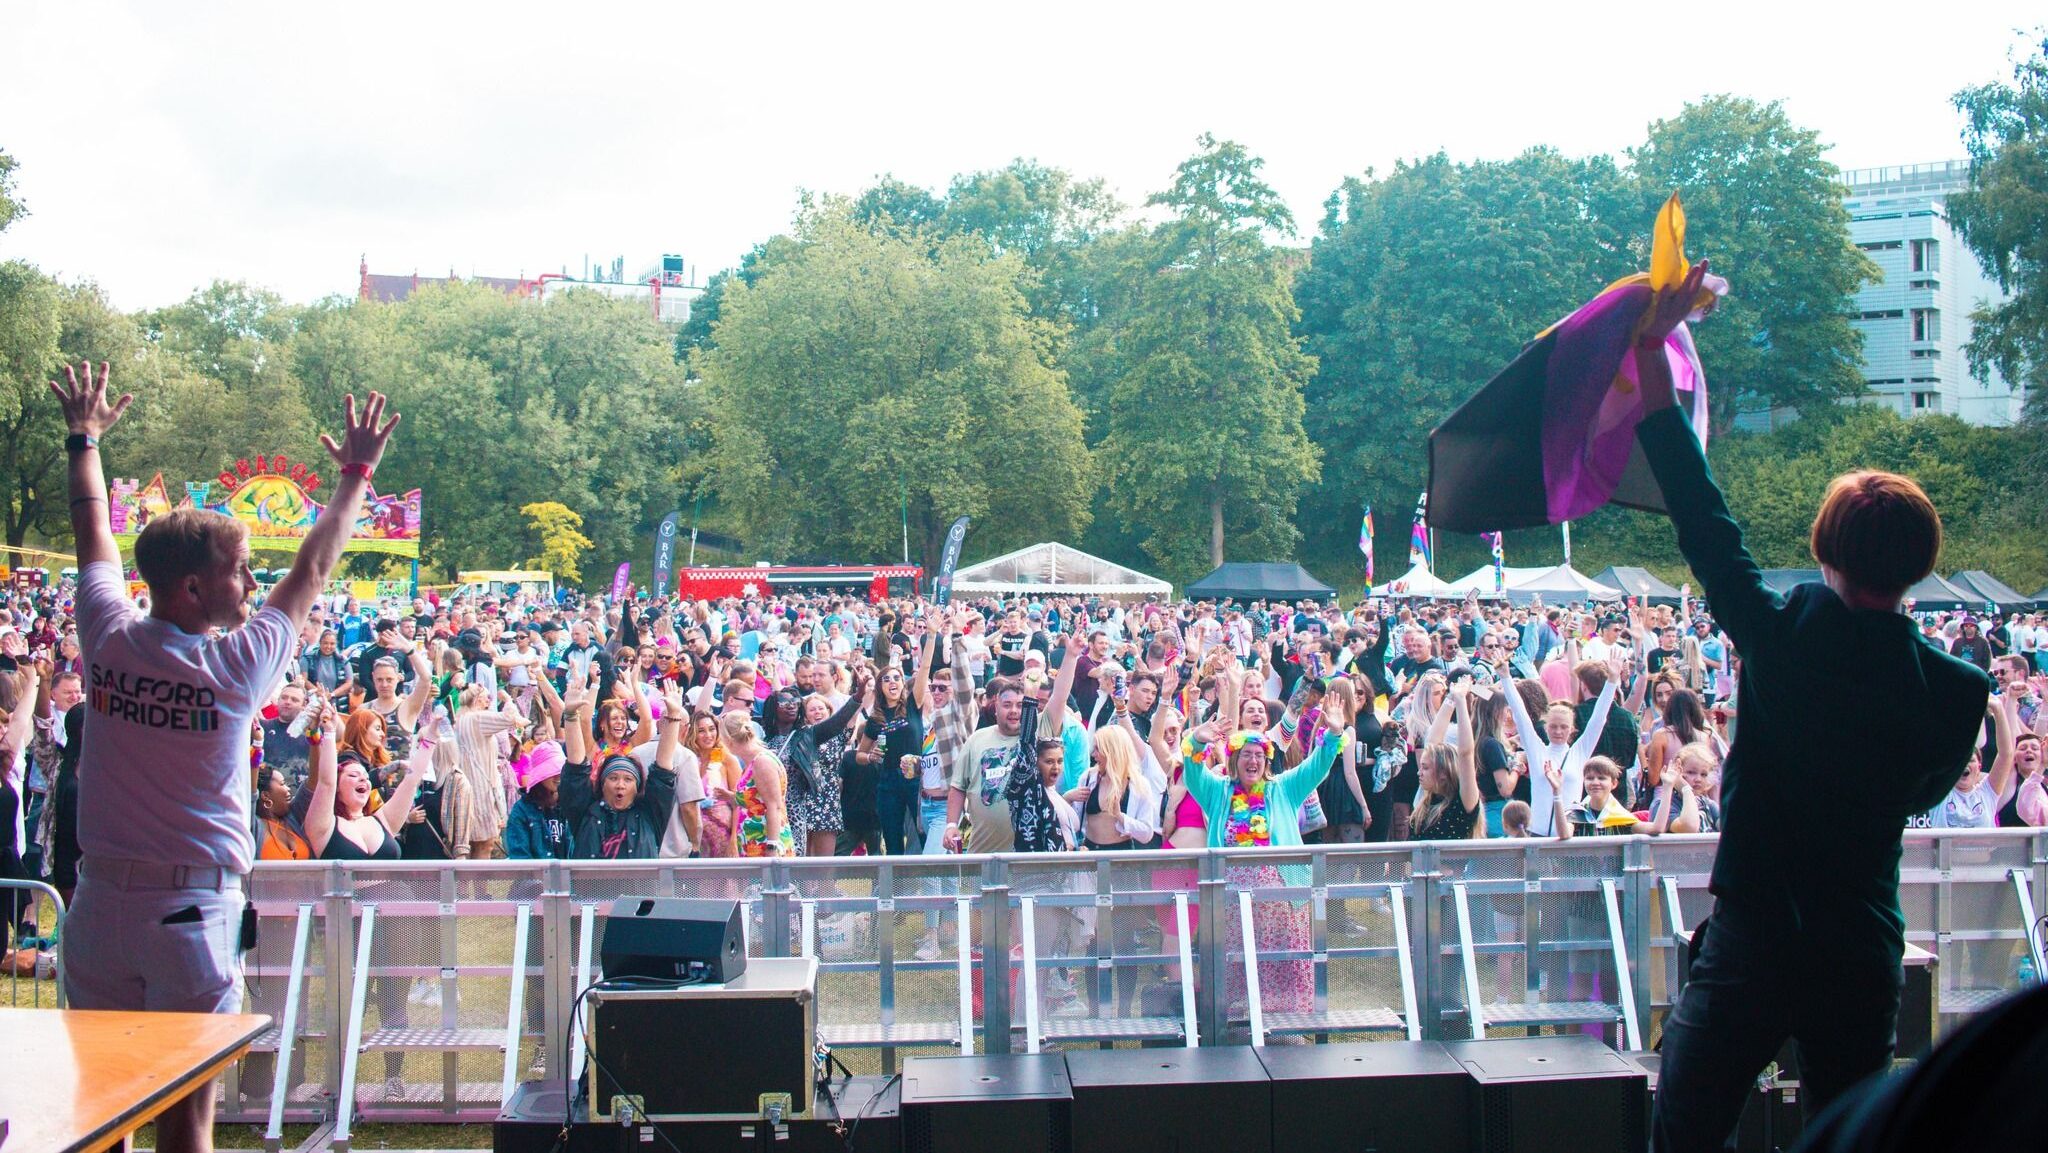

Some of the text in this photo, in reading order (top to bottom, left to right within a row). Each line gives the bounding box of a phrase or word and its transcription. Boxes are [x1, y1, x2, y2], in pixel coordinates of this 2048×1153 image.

[218, 454, 320, 493] DRAGON
[660, 543, 668, 569] BAR
[944, 546, 955, 573] BAR
[92, 663, 216, 707] SALFORD
[109, 694, 190, 730] PRIDE
[921, 757, 939, 769] OUD
